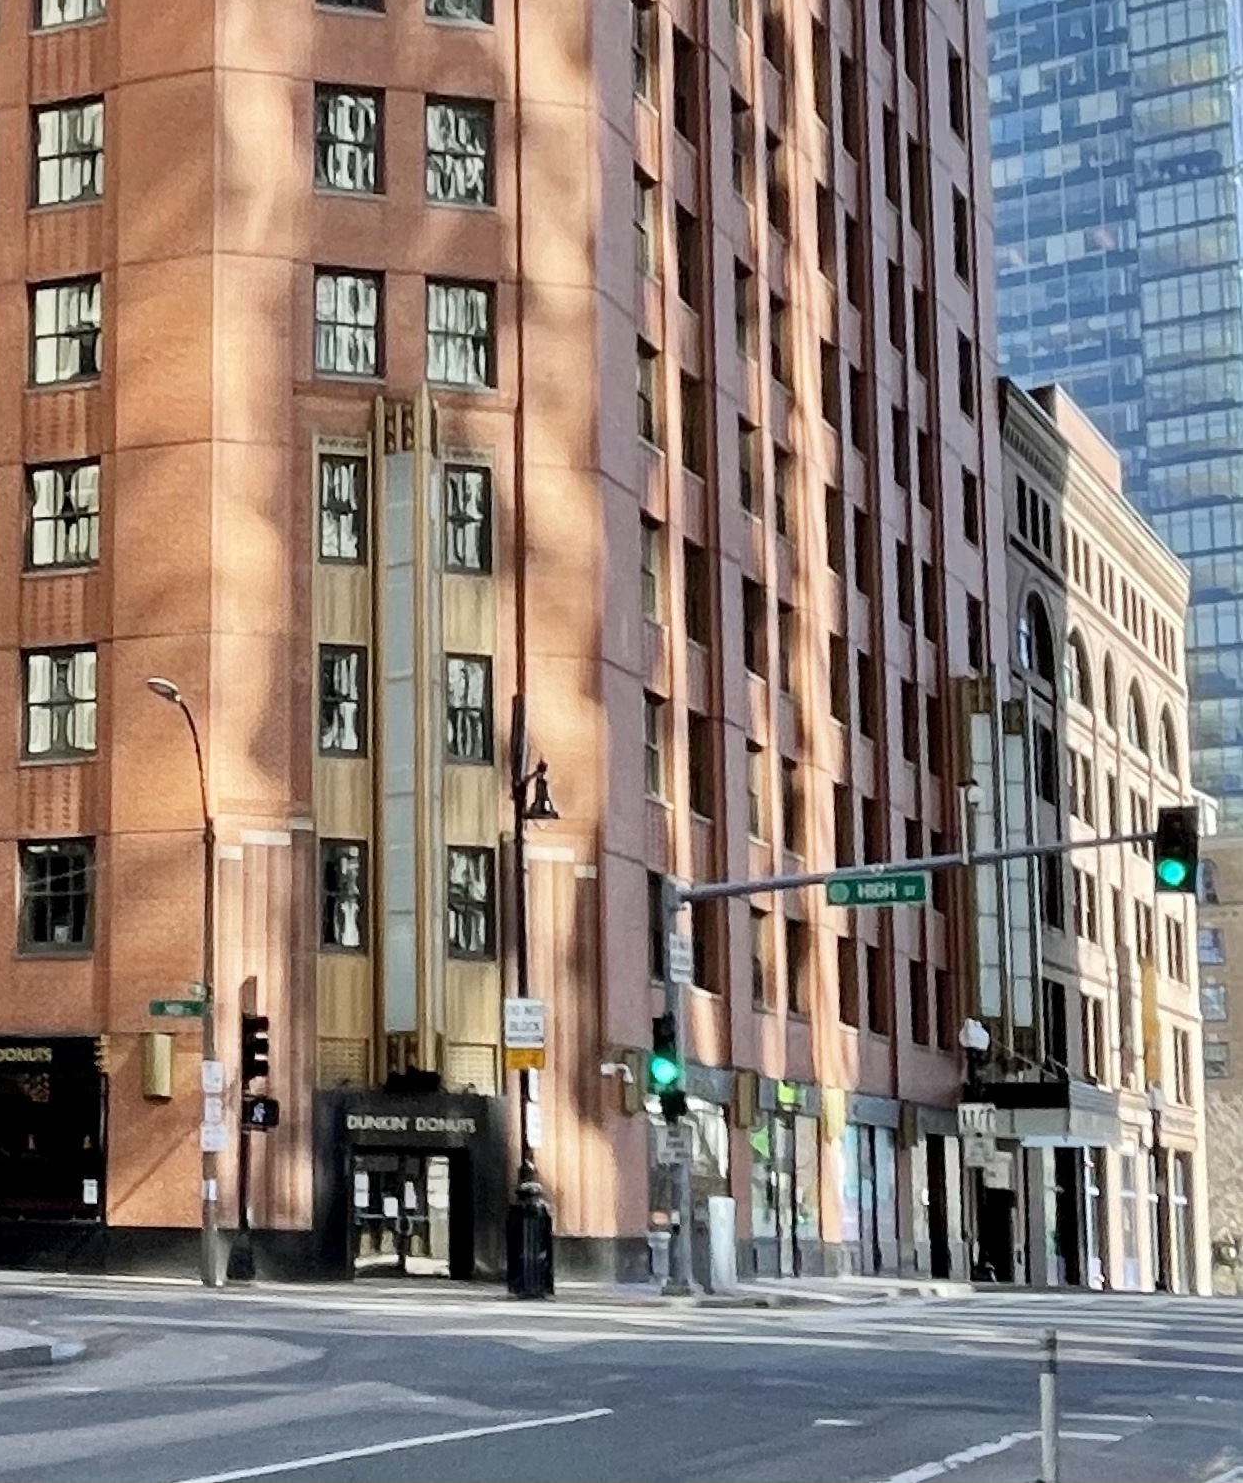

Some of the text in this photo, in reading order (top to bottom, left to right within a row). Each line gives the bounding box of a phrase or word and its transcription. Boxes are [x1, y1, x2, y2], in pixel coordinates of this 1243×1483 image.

[857, 881, 897, 899] HIGH
[509, 1021, 541, 1032] BLOCK
[415, 1116, 476, 1134] DONUTS
